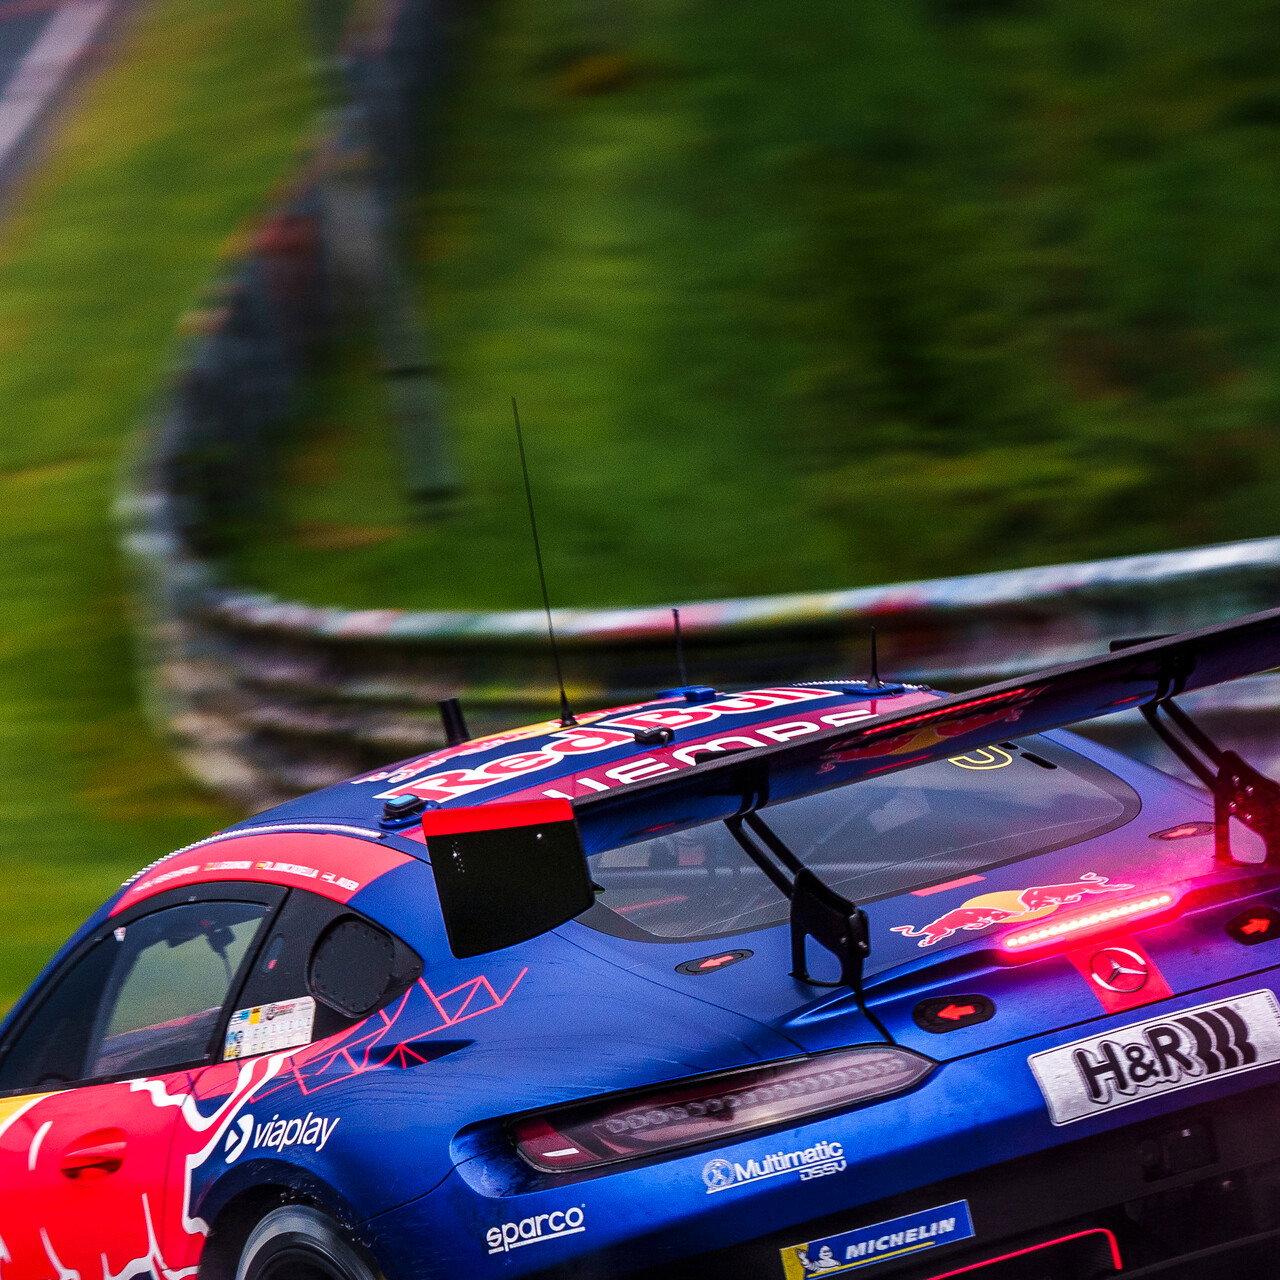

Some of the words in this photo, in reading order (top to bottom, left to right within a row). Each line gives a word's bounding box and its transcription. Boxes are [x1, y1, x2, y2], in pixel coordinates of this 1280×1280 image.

[373, 727, 637, 803] Red
[596, 686, 844, 731] Bull
[252, 1111, 340, 1153] viaplay
[734, 1140, 844, 1181] Multimatic
[486, 1205, 585, 1254] sparco
[844, 1216, 956, 1259] MICHELIN
